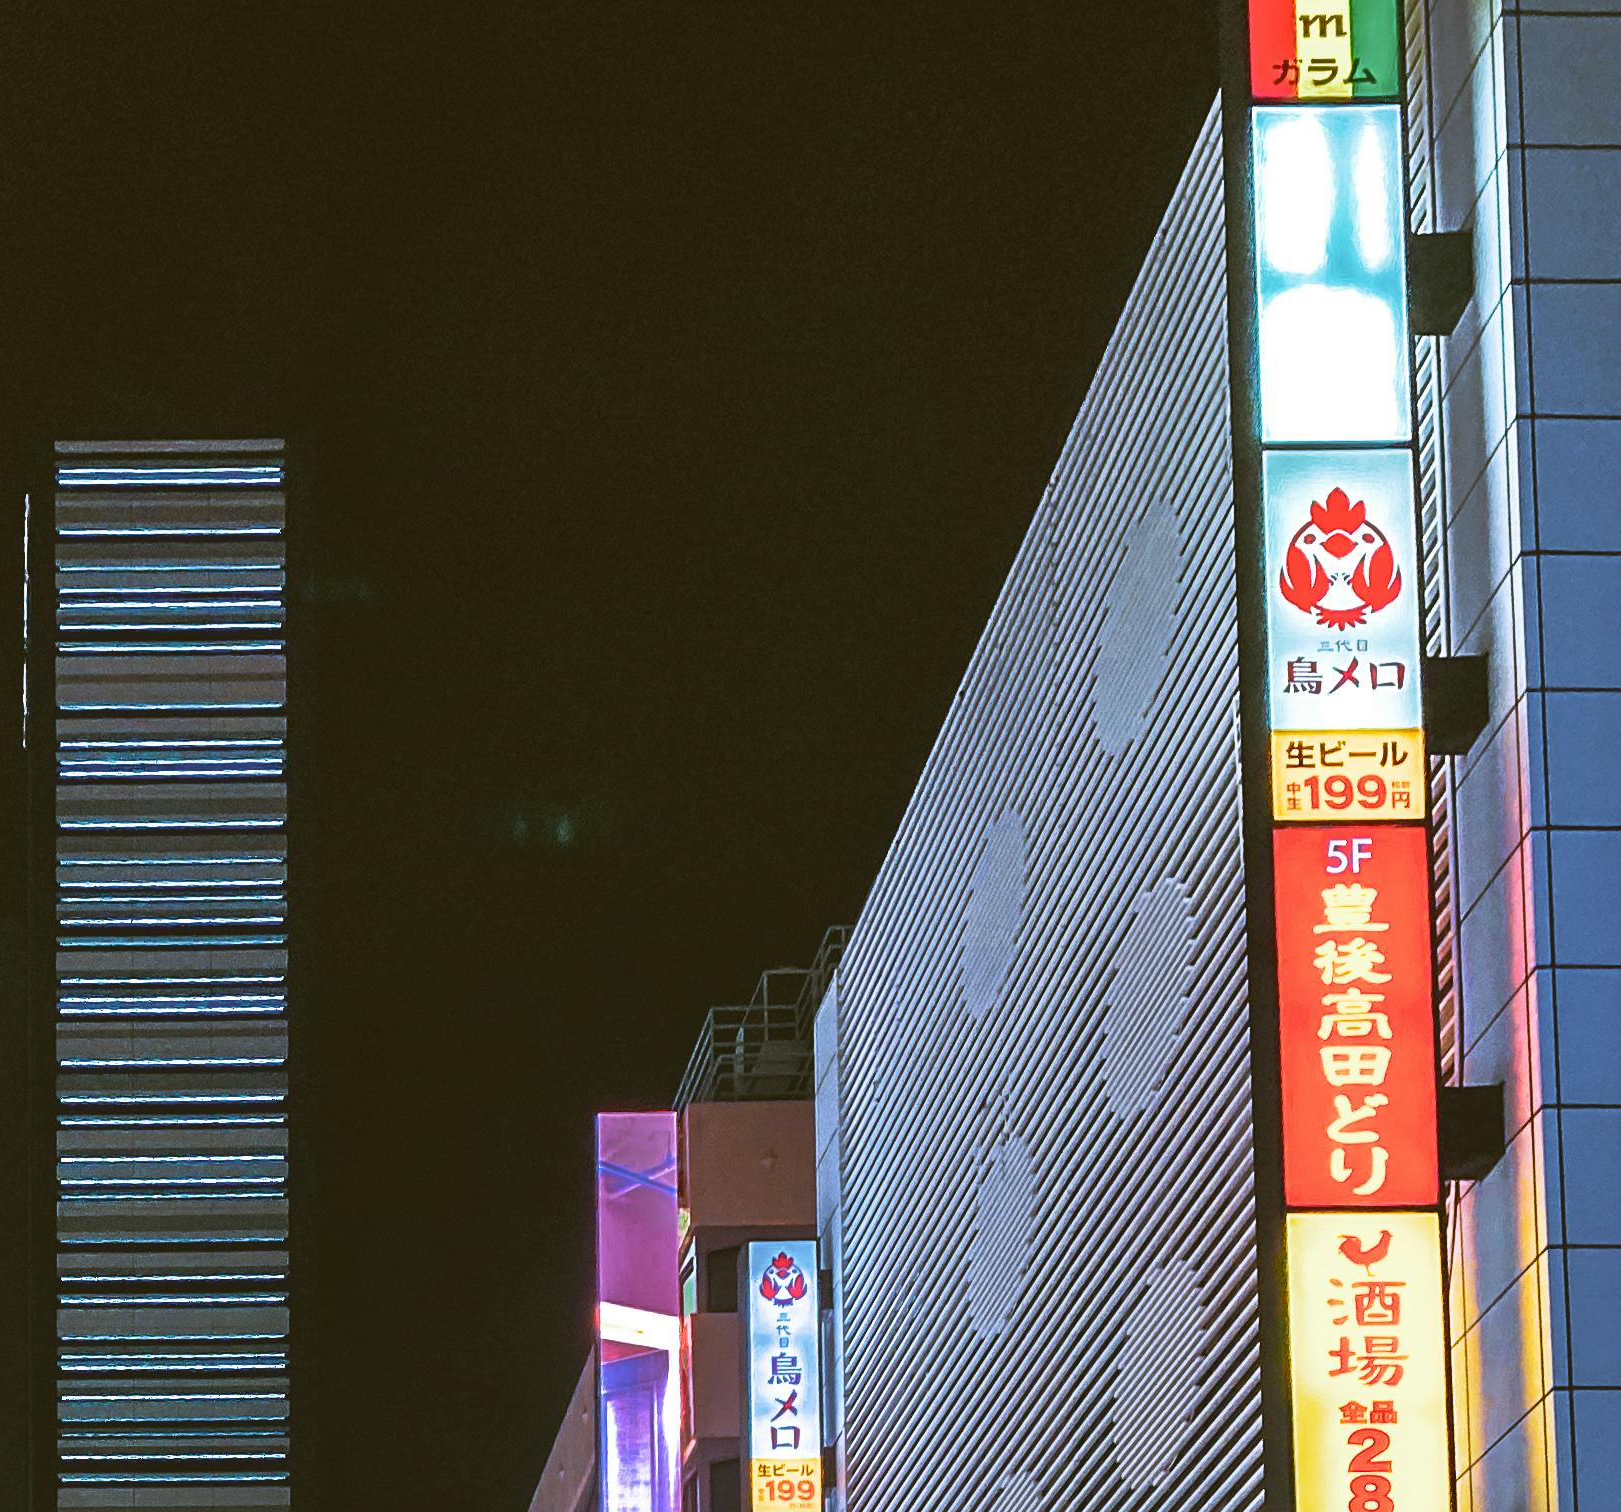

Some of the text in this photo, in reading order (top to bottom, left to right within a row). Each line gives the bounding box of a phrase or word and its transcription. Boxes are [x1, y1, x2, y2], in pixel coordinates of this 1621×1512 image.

[1272, 58, 1376, 87] ガラム
[1317, 639, 1369, 653] 三代目
[1283, 656, 1406, 696] 鳥メロ
[1286, 741, 1408, 769] 生ビール
[1326, 839, 1373, 874] 5F
[1313, 883, 1393, 1198] 豊後高田どり
[777, 1312, 790, 1348] 三代目
[1327, 1277, 1409, 1388] 酒場
[767, 1353, 802, 1451] 鳥メロ
[1338, 1400, 1398, 1424] 全品
[758, 1463, 814, 1478] 生ビール
[765, 1480, 816, 1503] 199
